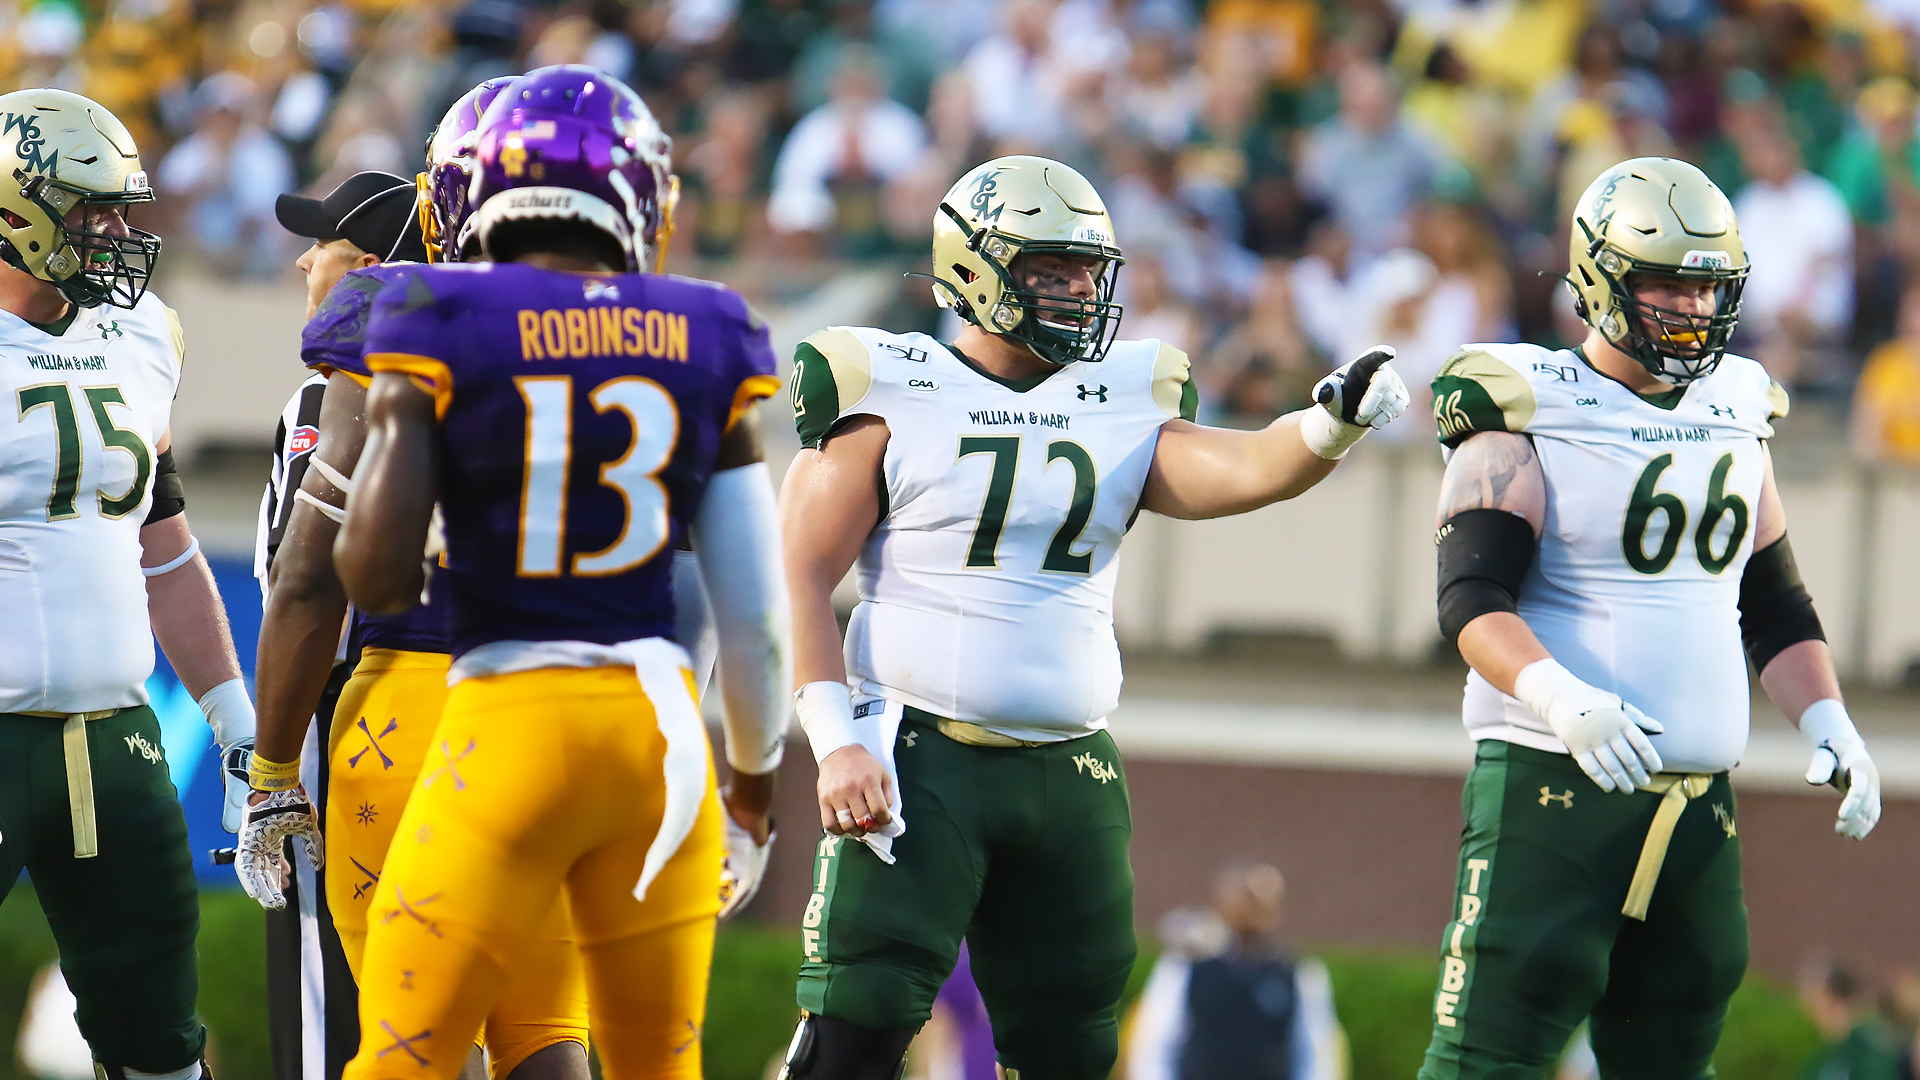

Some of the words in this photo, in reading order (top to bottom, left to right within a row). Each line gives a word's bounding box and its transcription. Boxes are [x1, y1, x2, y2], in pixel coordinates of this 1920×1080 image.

[3, 113, 58, 179] W&M
[510, 194, 573, 209] schutt
[517, 306, 689, 363] ROBINSON
[27, 354, 73, 370] WILLIAM
[74, 356, 81, 370] &
[83, 355, 107, 370] MARY
[908, 379, 934, 388] CAA
[1576, 398, 1599, 406] CAA
[968, 410, 1025, 425] WILLIAM
[1029, 412, 1038, 425] &
[1040, 413, 1070, 430] MARY
[1631, 427, 1675, 442] WILLIAM
[1676, 428, 1683, 442] &
[1685, 427, 1711, 442] MARY
[15, 381, 152, 523] 75
[291, 438, 310, 449] CFO
[512, 375, 681, 578] 13
[953, 433, 1099, 578] 72
[1620, 450, 1749, 577] 66
[123, 731, 163, 765] W&M
[1072, 751, 1118, 784] W&M
[803, 835, 840, 963] RIBE
[1436, 859, 1489, 1027] TRIBE
